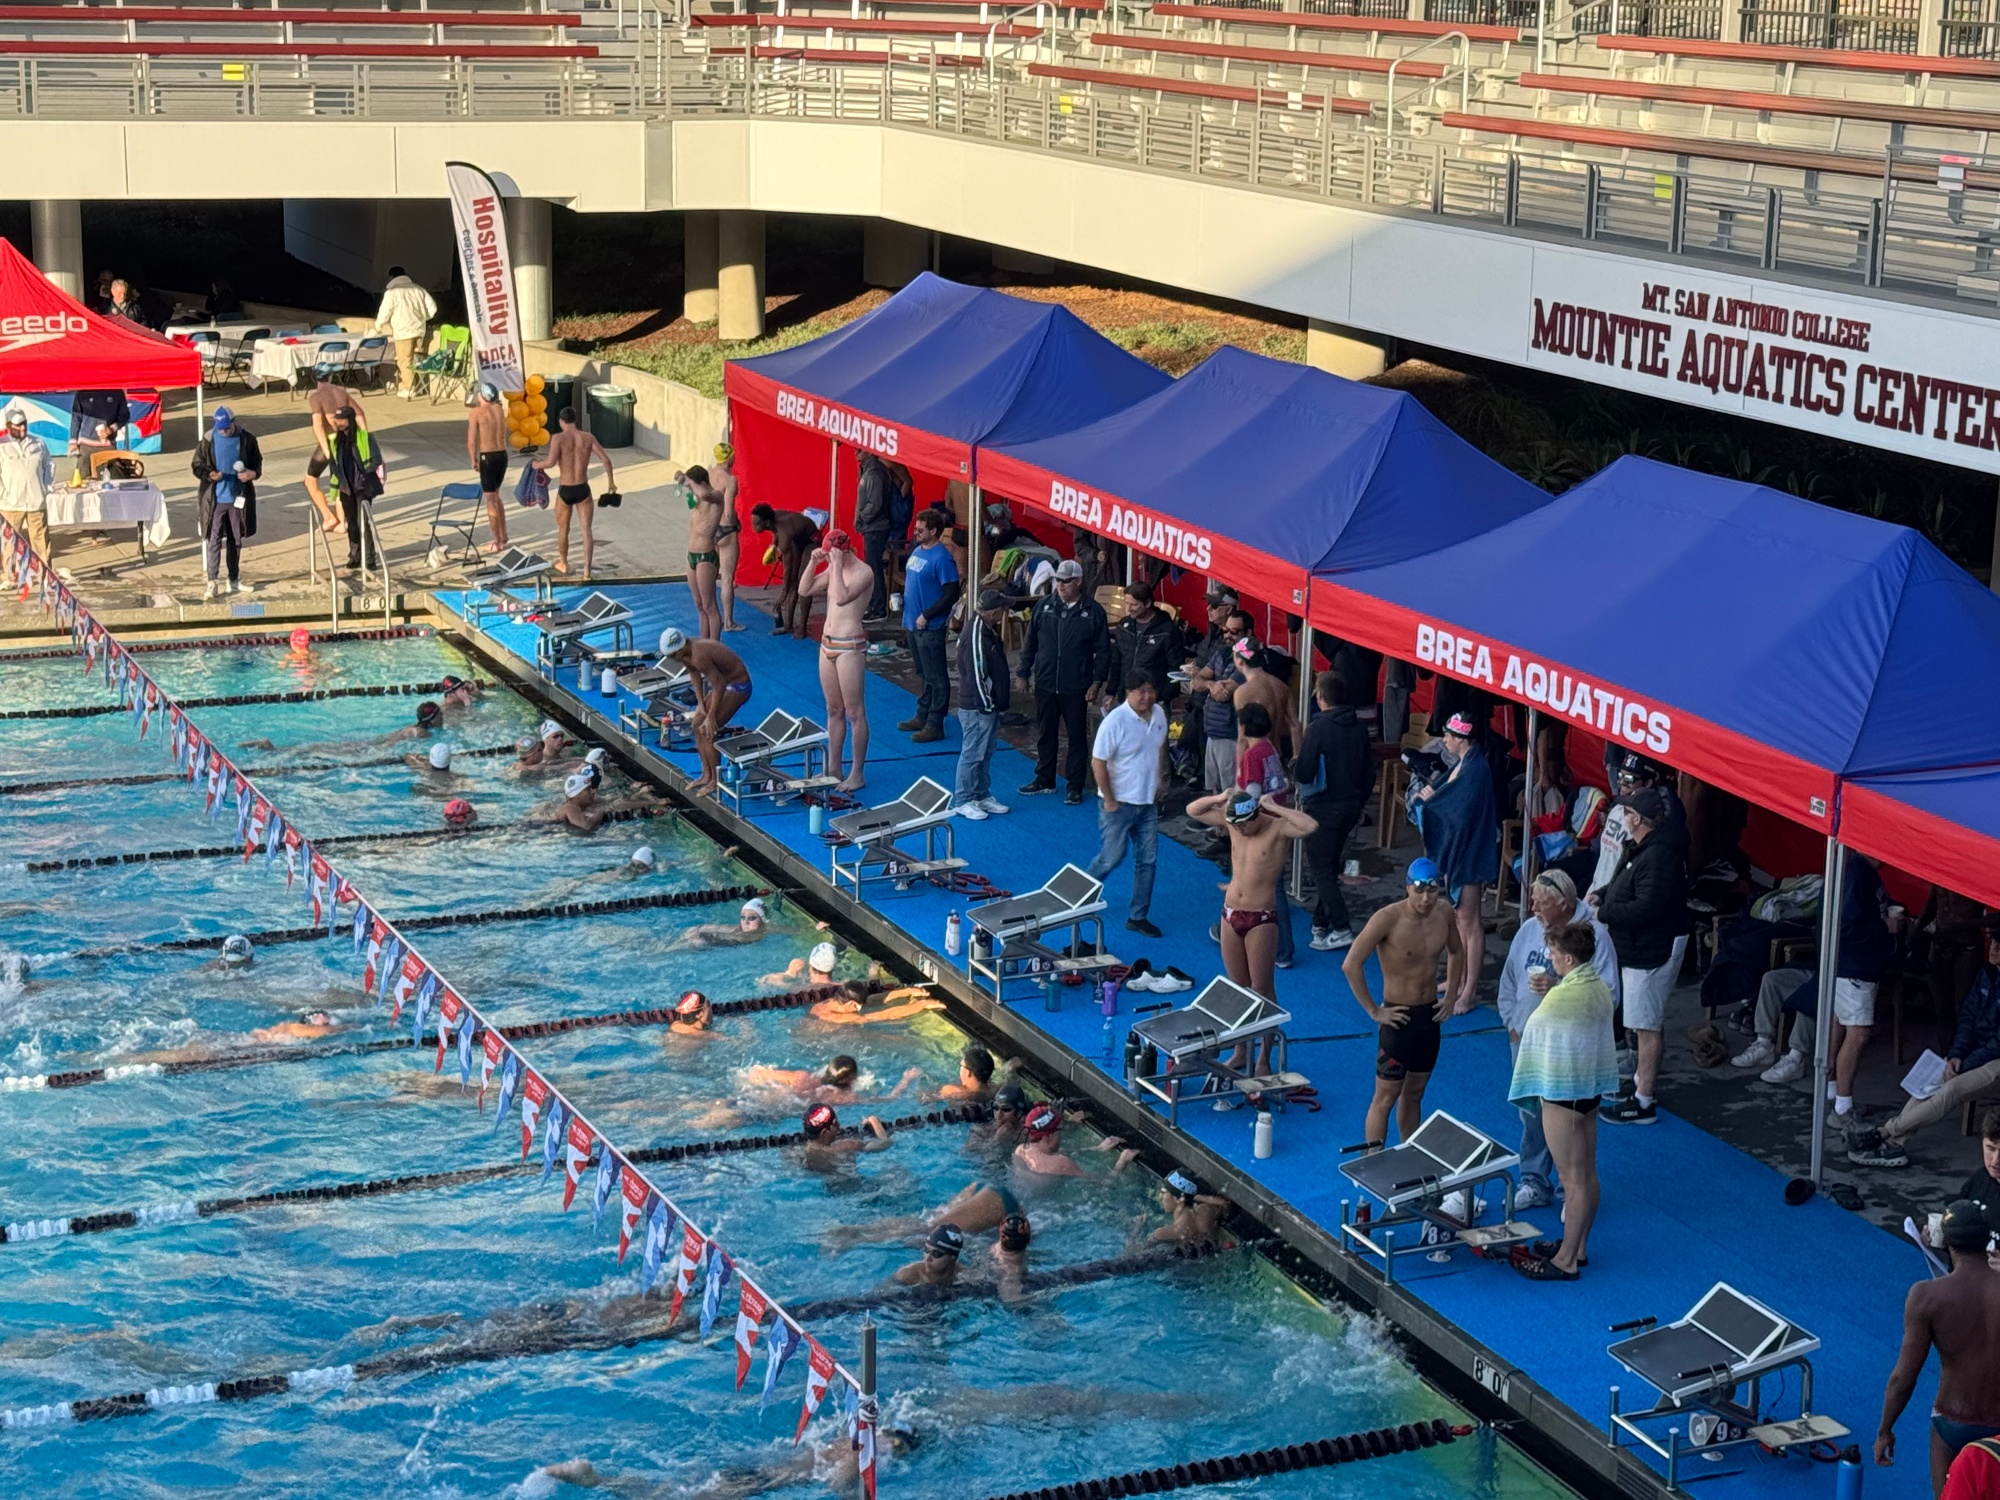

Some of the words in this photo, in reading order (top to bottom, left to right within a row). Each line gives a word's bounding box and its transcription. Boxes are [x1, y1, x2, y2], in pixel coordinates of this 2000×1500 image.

[472, 197, 508, 334] Hospitality
[1641, 282, 1671, 314] MT.
[1674, 289, 1711, 322] SAN
[1712, 296, 1789, 337] ANTONIO
[1791, 310, 1872, 352] COLLEGE
[1531, 298, 1672, 379] MOUNTIE
[1676, 328, 1848, 417] AQUATICS
[1853, 363, 2000, 452] CENTER
[776, 389, 815, 428] BREA
[817, 404, 899, 457] AQUATICS
[1048, 479, 1103, 530] BREA
[1105, 503, 1213, 570] AQUATICS
[501, 599, 509, 612] 1
[1415, 622, 1495, 685] BREA
[1500, 654, 1672, 755] AQUATICS
[765, 779, 774, 792] 4
[889, 861, 898, 875] 5
[1030, 957, 1041, 972] 6
[1210, 1076, 1219, 1093] 7
[1427, 1226, 1438, 1245] 8
[1716, 1421, 1728, 1441] 9
